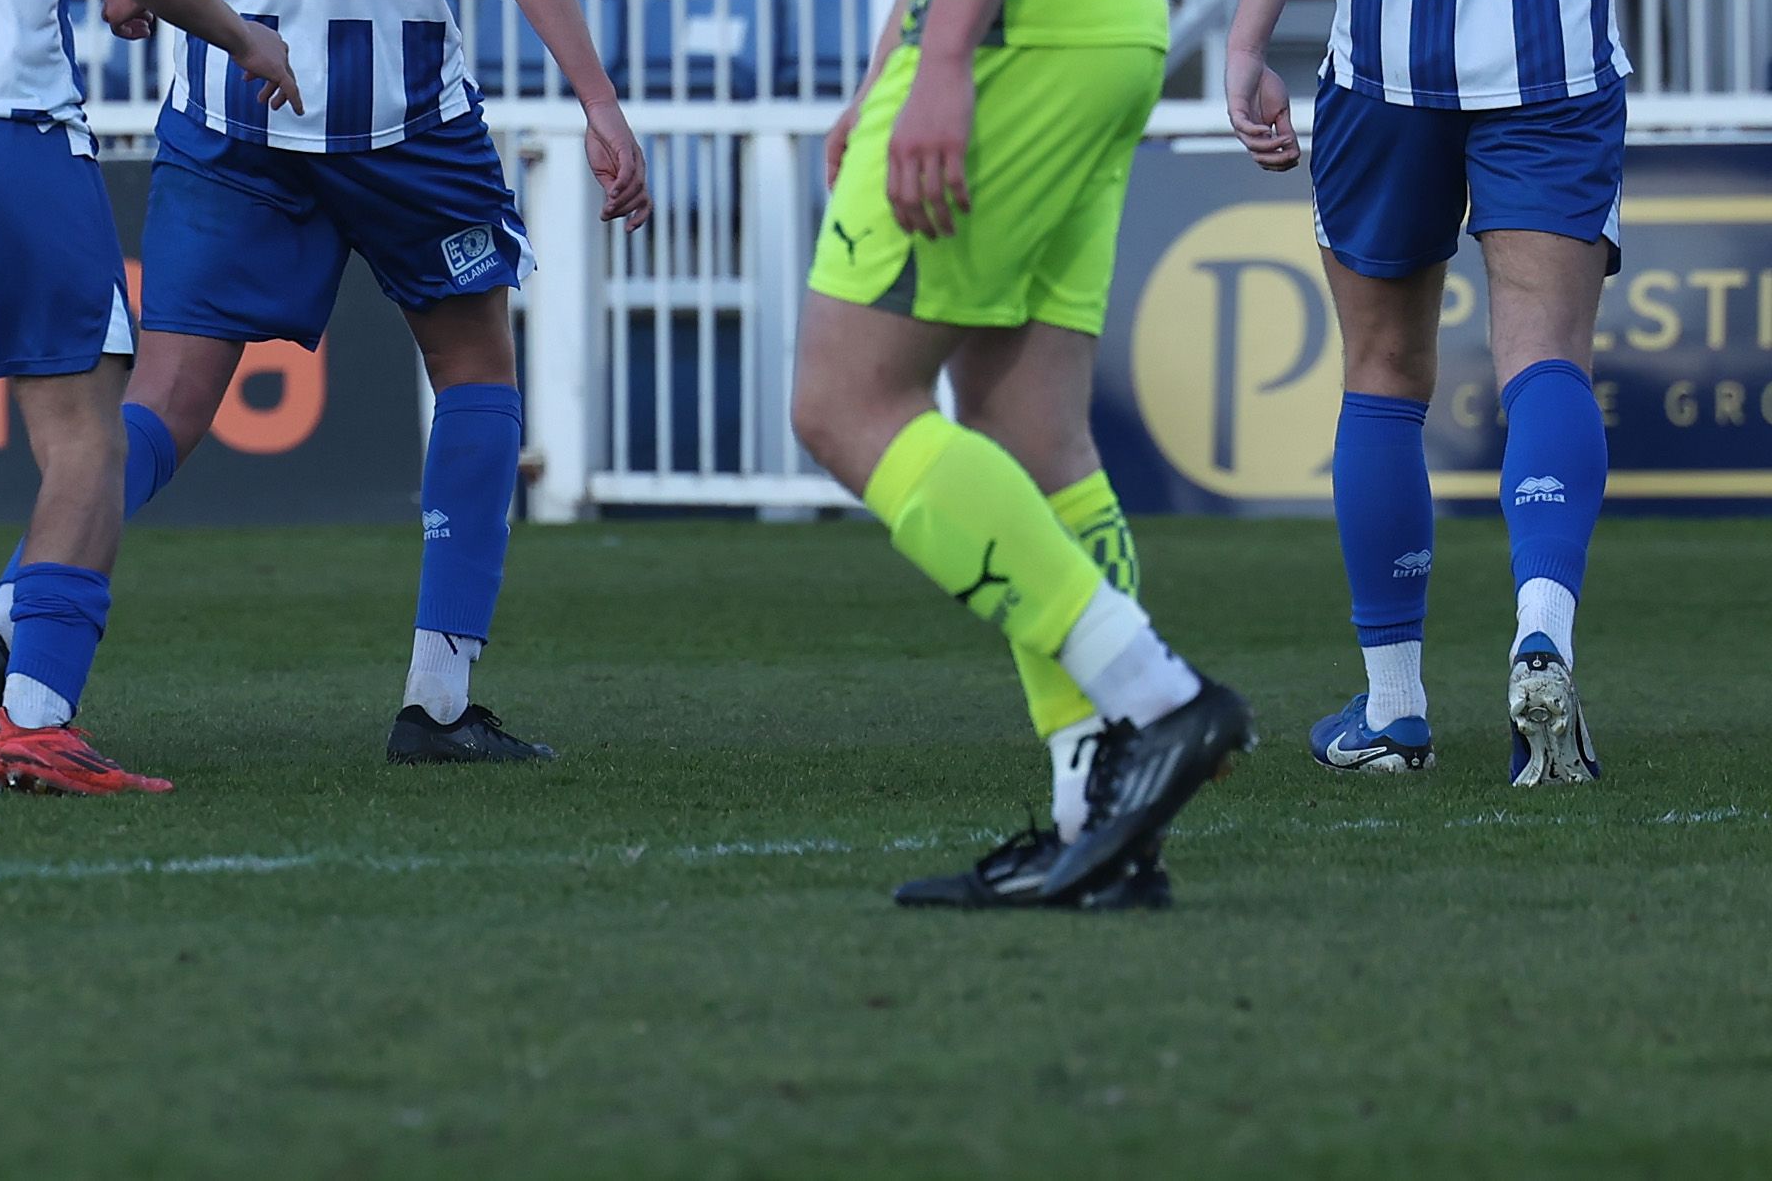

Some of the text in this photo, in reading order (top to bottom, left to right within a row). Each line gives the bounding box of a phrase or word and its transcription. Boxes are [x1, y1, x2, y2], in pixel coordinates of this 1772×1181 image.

[447, 241, 467, 269] LFF
[458, 256, 499, 286] GLAMAL
[1515, 492, 1566, 506] errea
